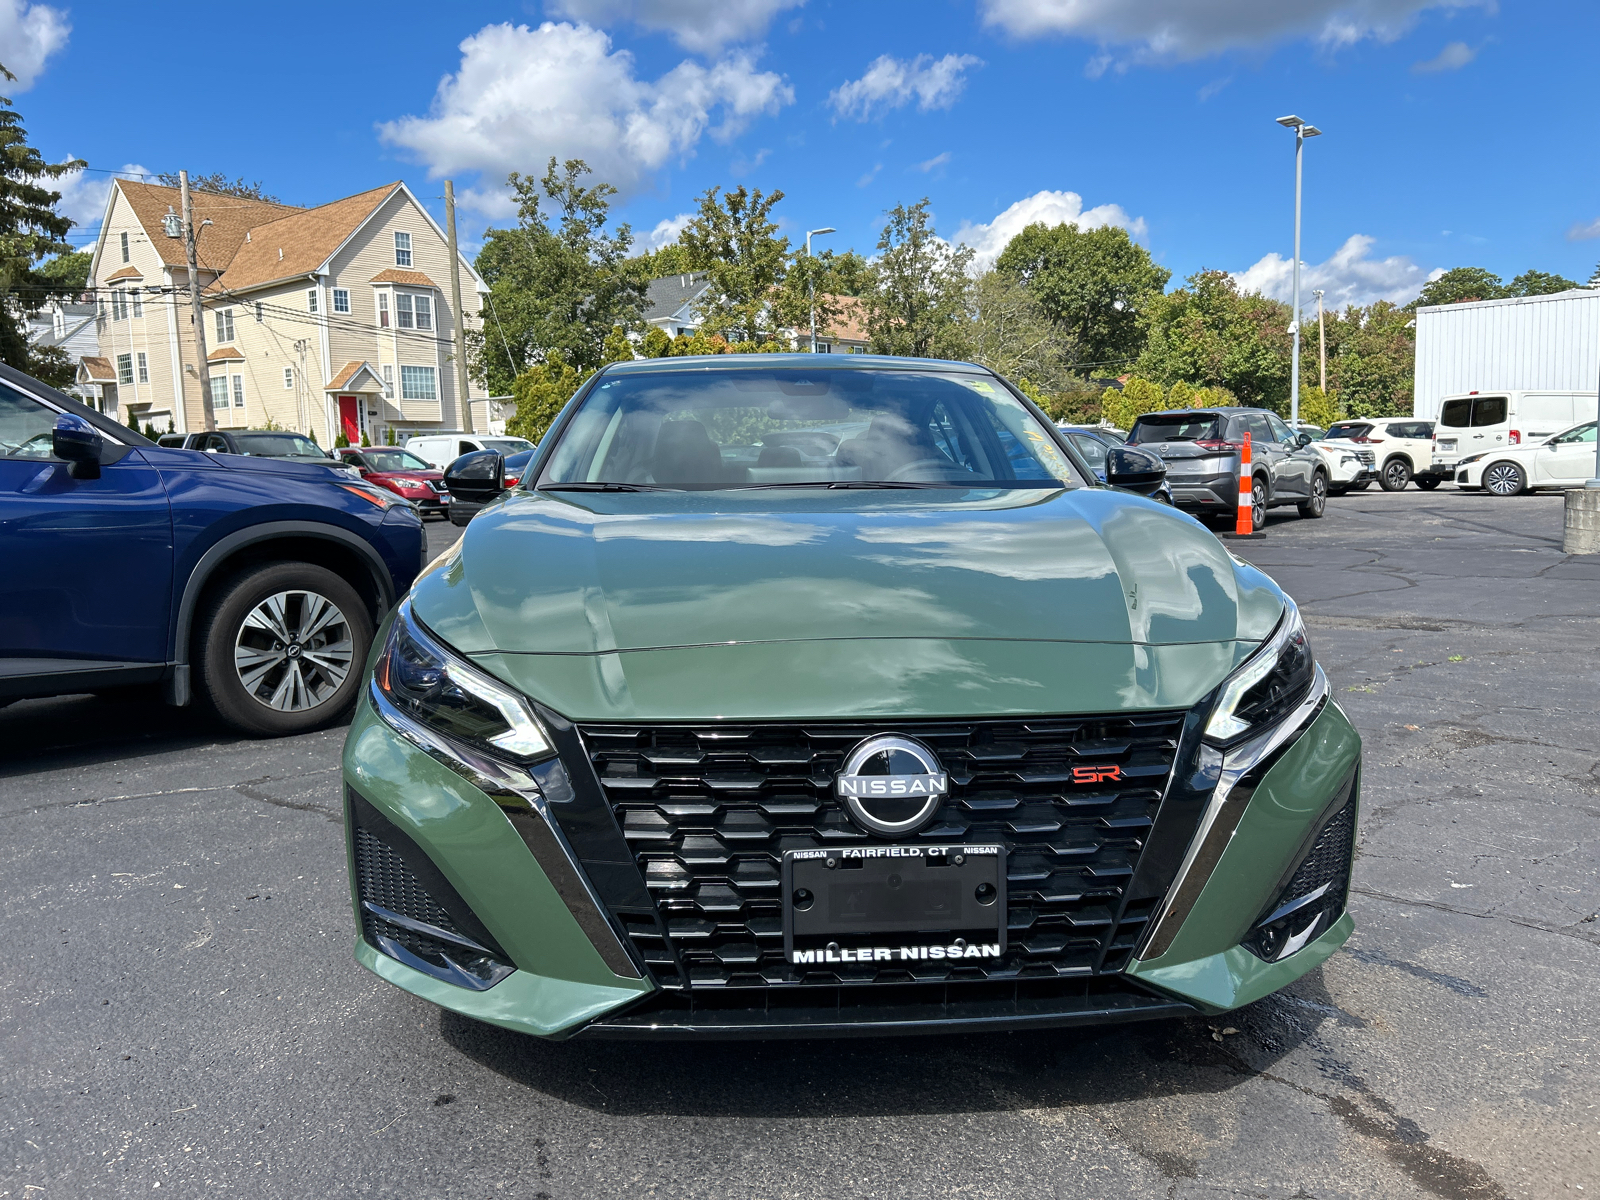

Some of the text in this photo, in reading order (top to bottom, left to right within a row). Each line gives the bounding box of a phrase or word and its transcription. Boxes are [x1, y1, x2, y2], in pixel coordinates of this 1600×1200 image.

[1073, 765, 1121, 783] SR
[840, 777, 945, 795] NISSAN
[793, 851, 827, 859] NISSAN
[842, 847, 949, 859] FAIRFIELD, CT
[793, 943, 1000, 963] MILLER NISSAN
